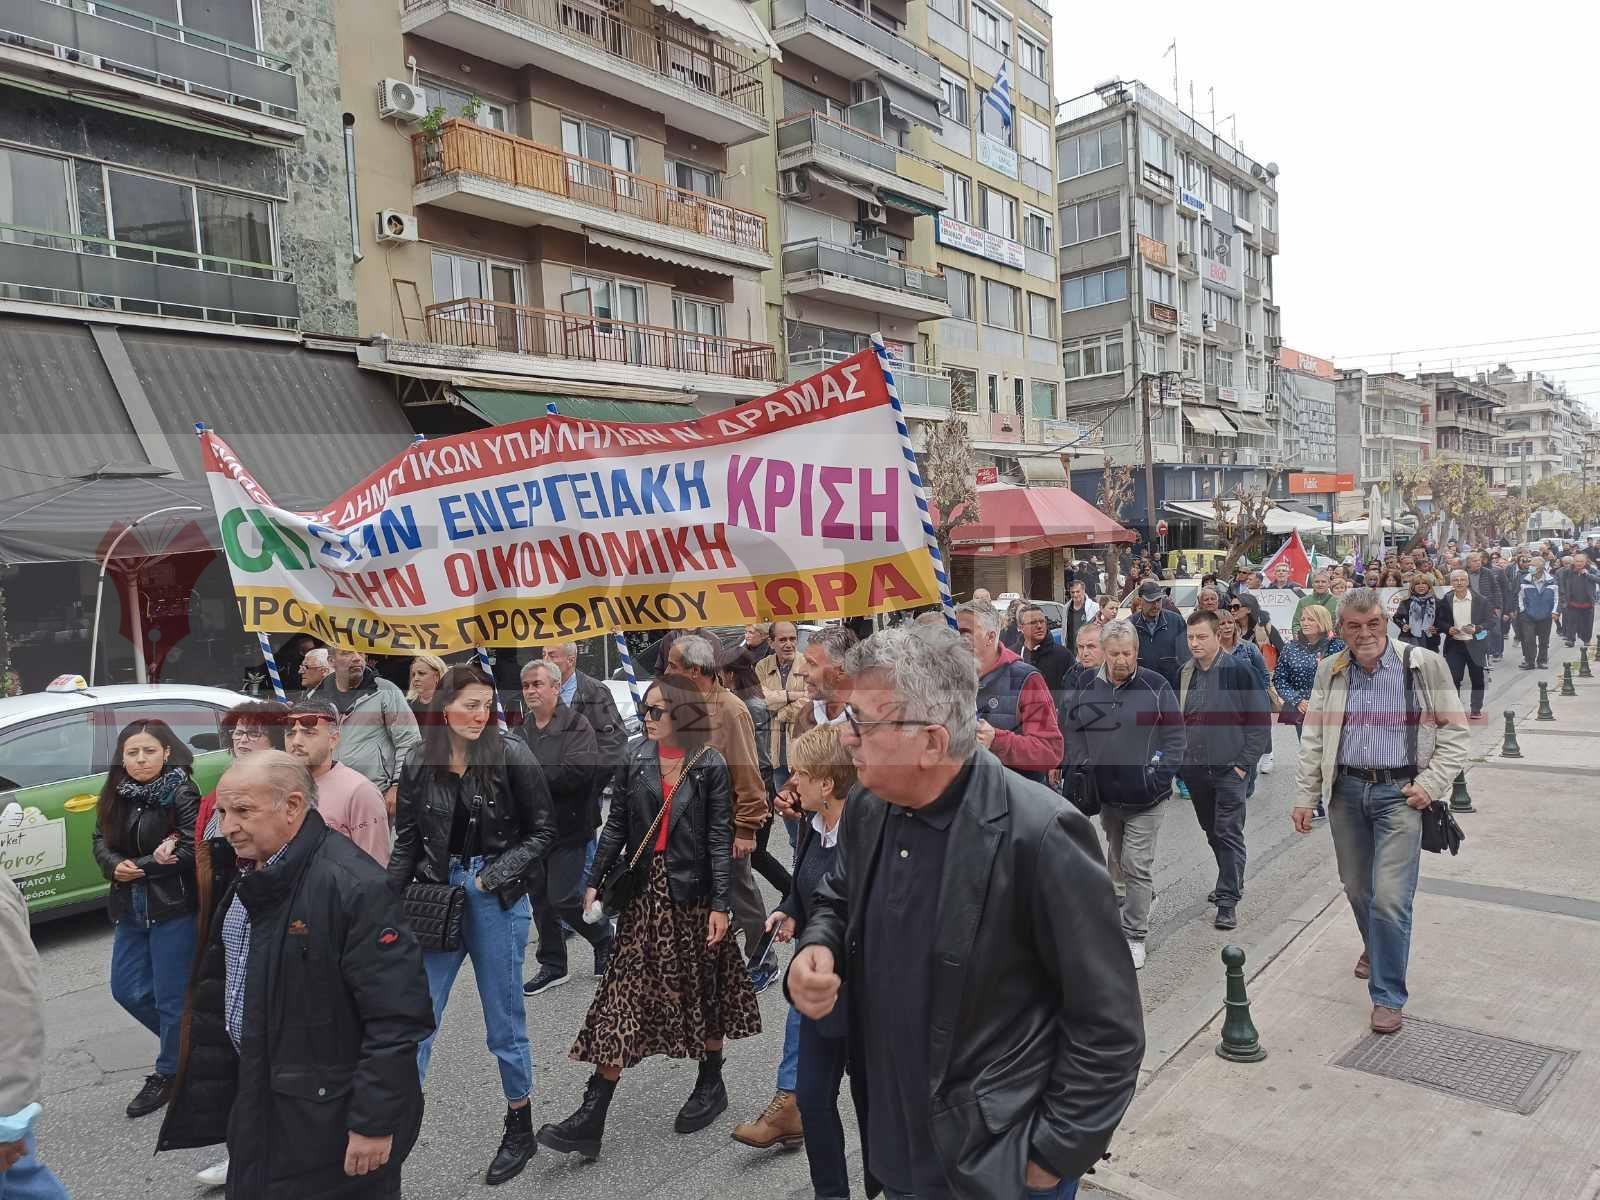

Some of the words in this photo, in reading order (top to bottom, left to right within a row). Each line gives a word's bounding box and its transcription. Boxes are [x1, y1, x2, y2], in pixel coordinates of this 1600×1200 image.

[717, 363, 866, 437] ΔΡΑΜΑΣ
[440, 460, 711, 541] ΕΝΕΡΓΕΙΑΚΗ
[727, 454, 899, 542] ΚΡΙΣΗ
[444, 522, 737, 597] ΟΙΚΟΝΟΜΙΚΗ
[456, 590, 708, 645] ΠΡΟΣΩΠΙΚΟΥ
[717, 562, 923, 618] ΤΩΡΑ
[55, 872, 66, 881] 56
